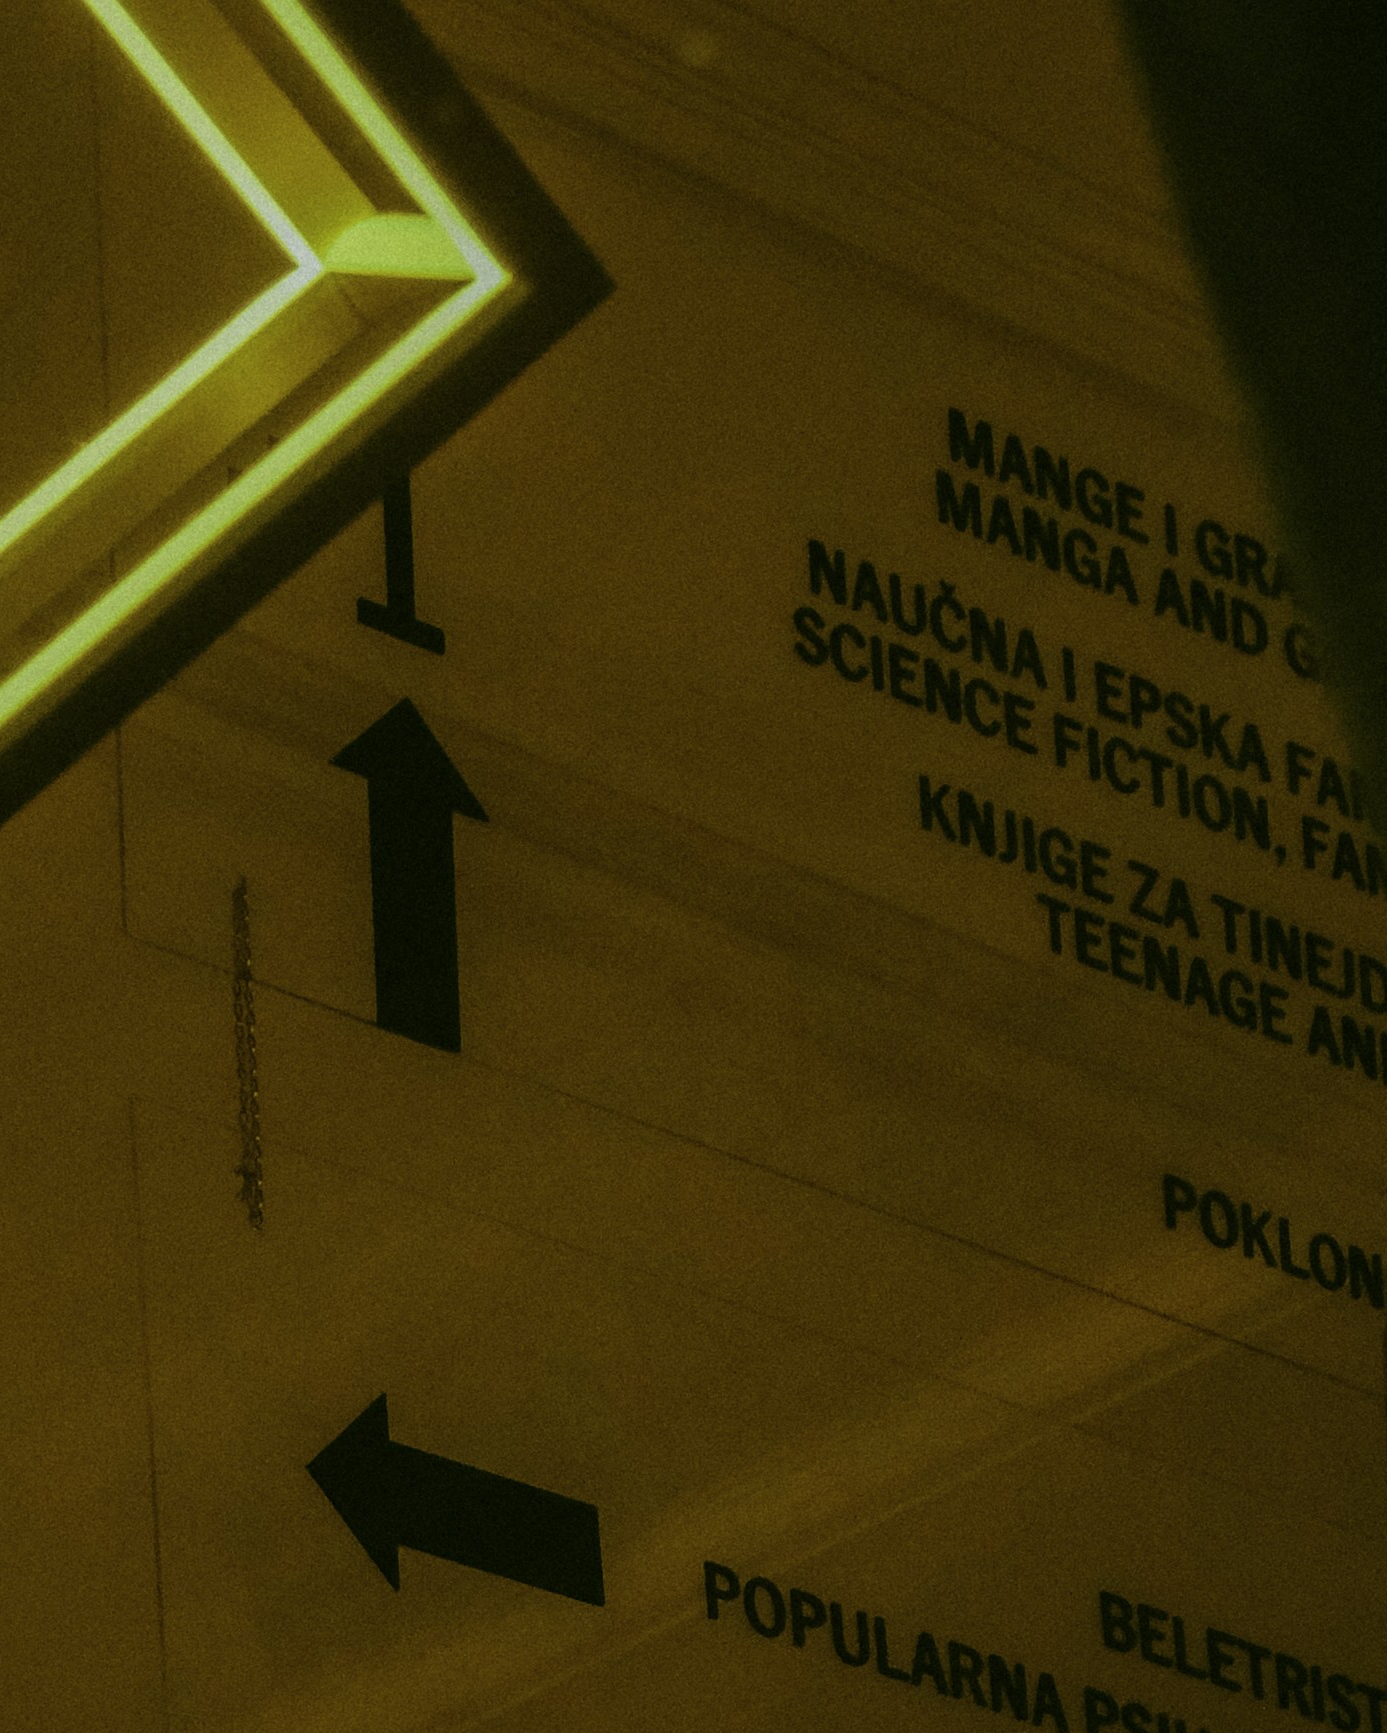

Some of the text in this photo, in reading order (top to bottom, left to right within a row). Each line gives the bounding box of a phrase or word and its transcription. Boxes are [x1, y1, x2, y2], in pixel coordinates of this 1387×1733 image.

[936, 469, 1139, 604] MANGA
[1155, 569, 1269, 656] AND
[949, 407, 1149, 544] MANGE
[1163, 503, 1179, 556] I
[793, 607, 1039, 756] SCIENCE
[1054, 714, 1289, 867] FICTION,
[808, 539, 1046, 690] NAUČNA
[1061, 647, 1077, 702] I
[1095, 660, 1272, 785] EPSKA
[917, 774, 1114, 904] KNJIGE
[1129, 860, 1200, 940] ZA
[1038, 892, 1293, 1045] TEENAGE
